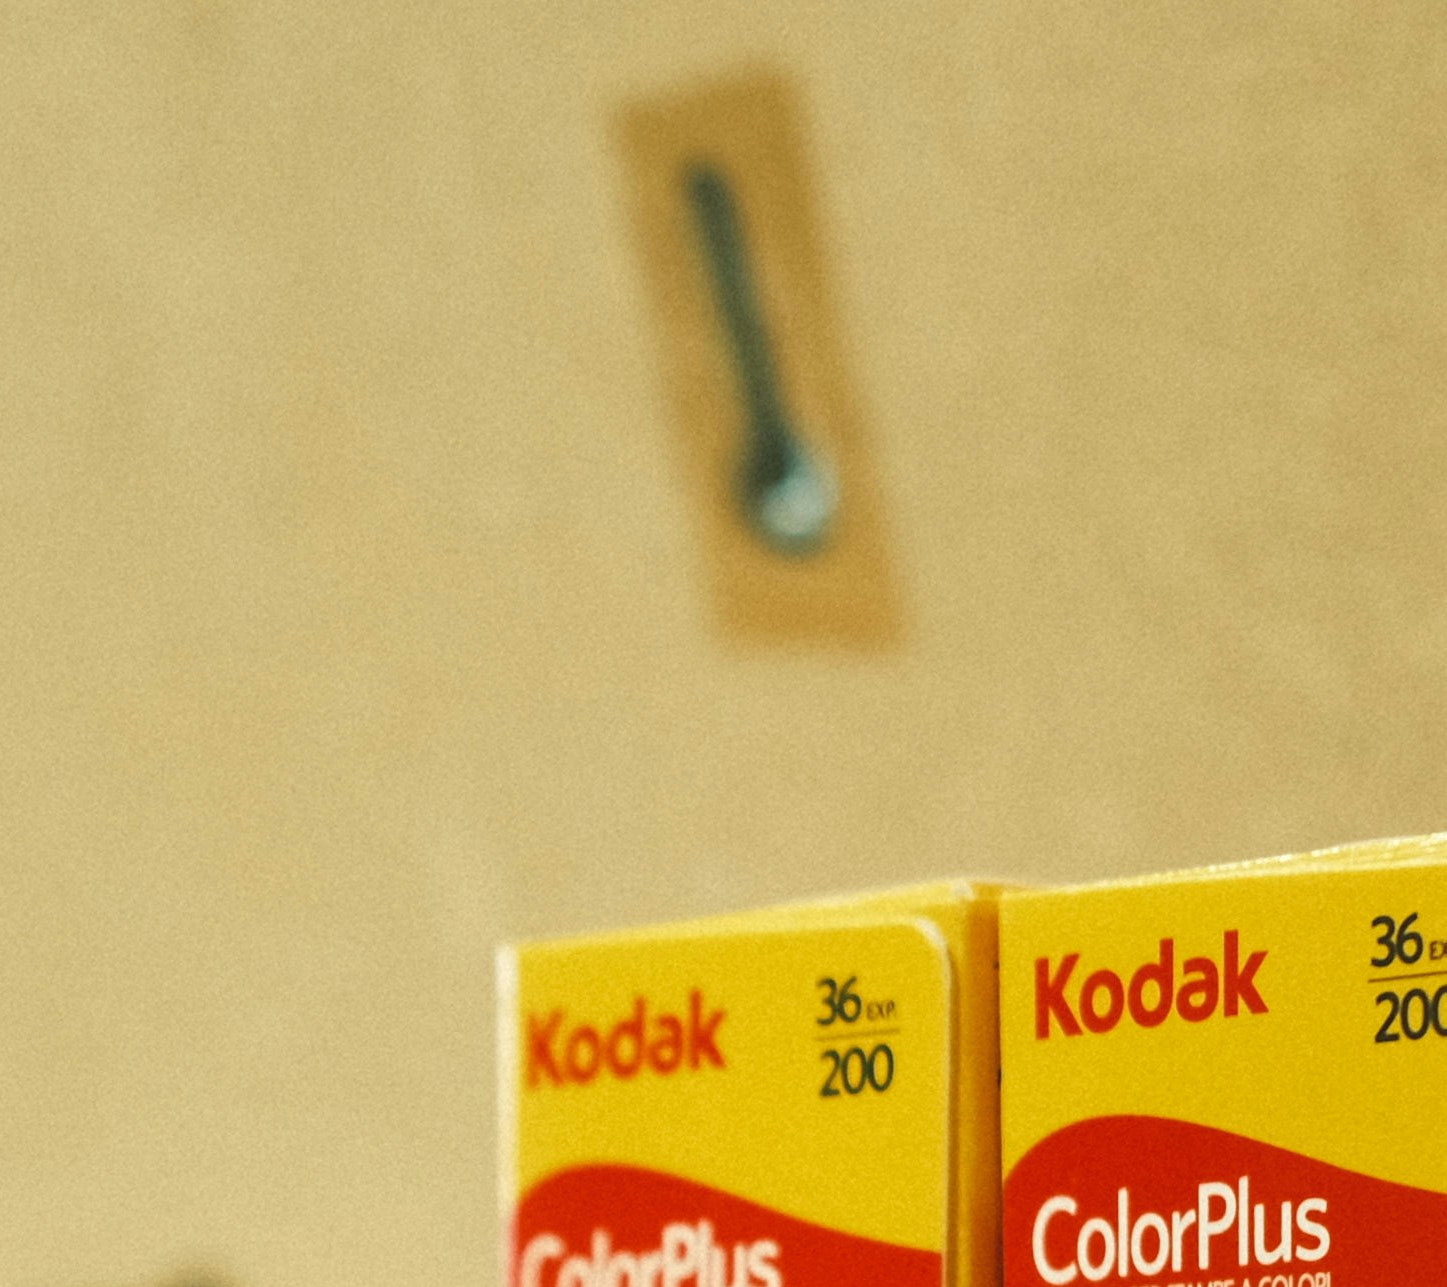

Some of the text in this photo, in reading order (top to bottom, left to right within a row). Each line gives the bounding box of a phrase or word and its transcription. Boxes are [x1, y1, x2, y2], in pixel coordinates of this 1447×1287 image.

[1369, 912, 1425, 969] 36
[814, 975, 861, 1029] 36
[1033, 928, 1271, 1041] Kodak
[525, 989, 726, 1090] Kodak
[819, 1043, 895, 1099] 200
[1030, 1175, 1331, 1286] ColorPlus
